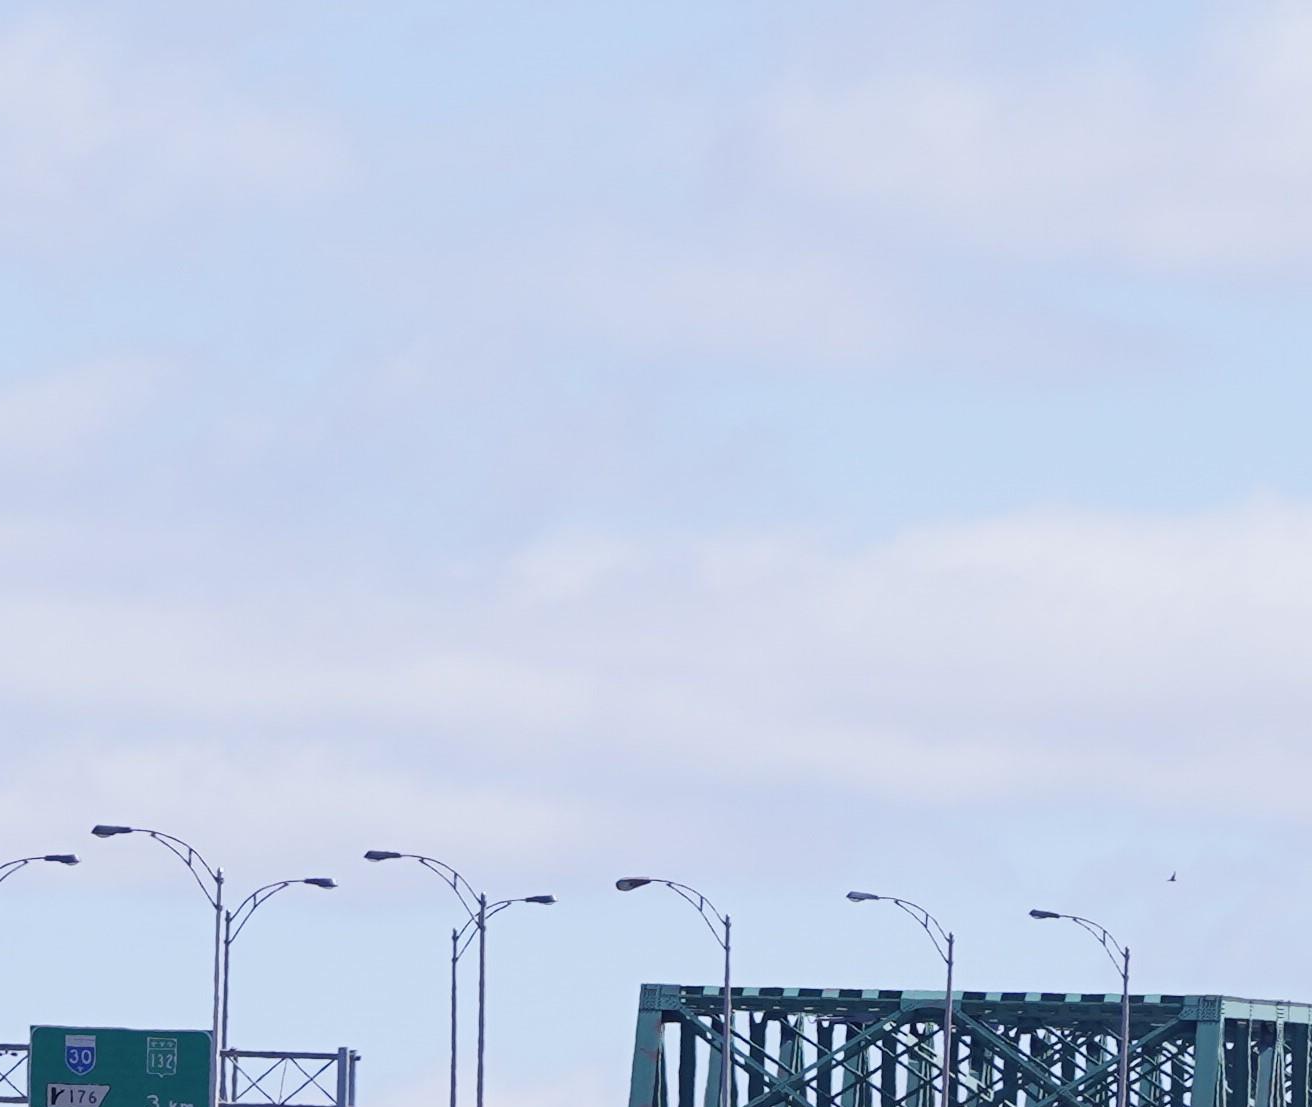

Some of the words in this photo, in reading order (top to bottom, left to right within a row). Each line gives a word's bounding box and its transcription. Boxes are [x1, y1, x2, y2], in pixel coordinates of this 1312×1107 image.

[69, 1049, 92, 1065] 30
[151, 1053, 174, 1069] 132
[70, 1089, 97, 1104] 176
